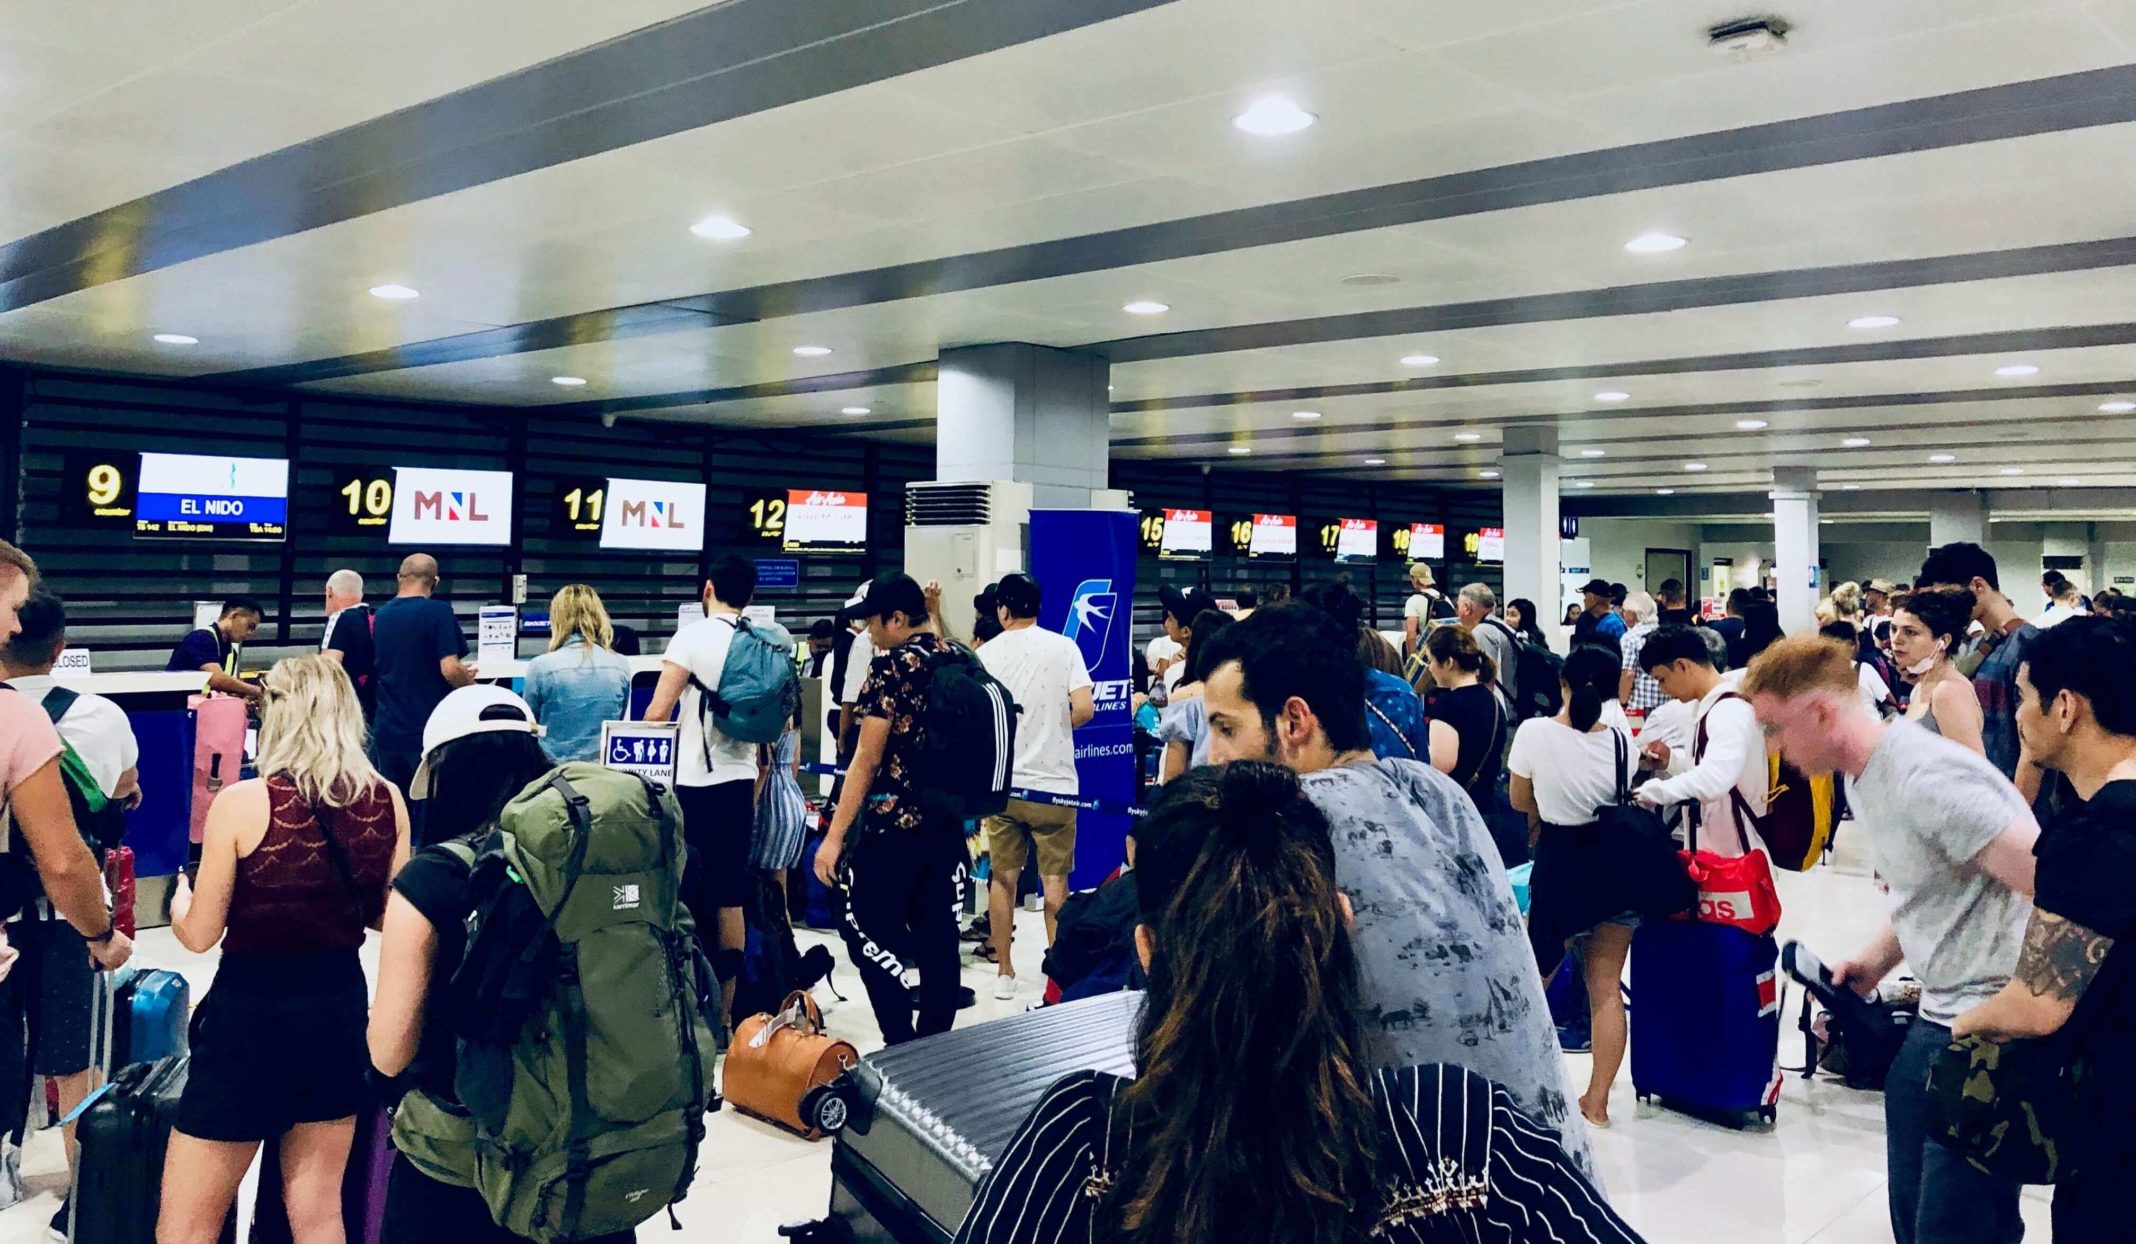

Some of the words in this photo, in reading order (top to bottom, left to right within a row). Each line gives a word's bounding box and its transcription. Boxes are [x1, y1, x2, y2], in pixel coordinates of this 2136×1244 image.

[88, 464, 121, 504] 9
[181, 499, 200, 515] EL
[205, 500, 244, 516] NIDO
[341, 478, 392, 516] 10
[414, 490, 489, 521] MNL
[564, 487, 604, 521] 11
[621, 499, 685, 529] MNL
[750, 498, 786, 529] 12
[1141, 517, 1163, 541] 15
[1231, 520, 1252, 544] 16
[1320, 524, 1340, 547] 17
[1392, 528, 1411, 550] 18
[1094, 702, 1127, 711] LINES
[1074, 743, 1133, 759] airlines.com
[650, 769, 673, 777] LANE
